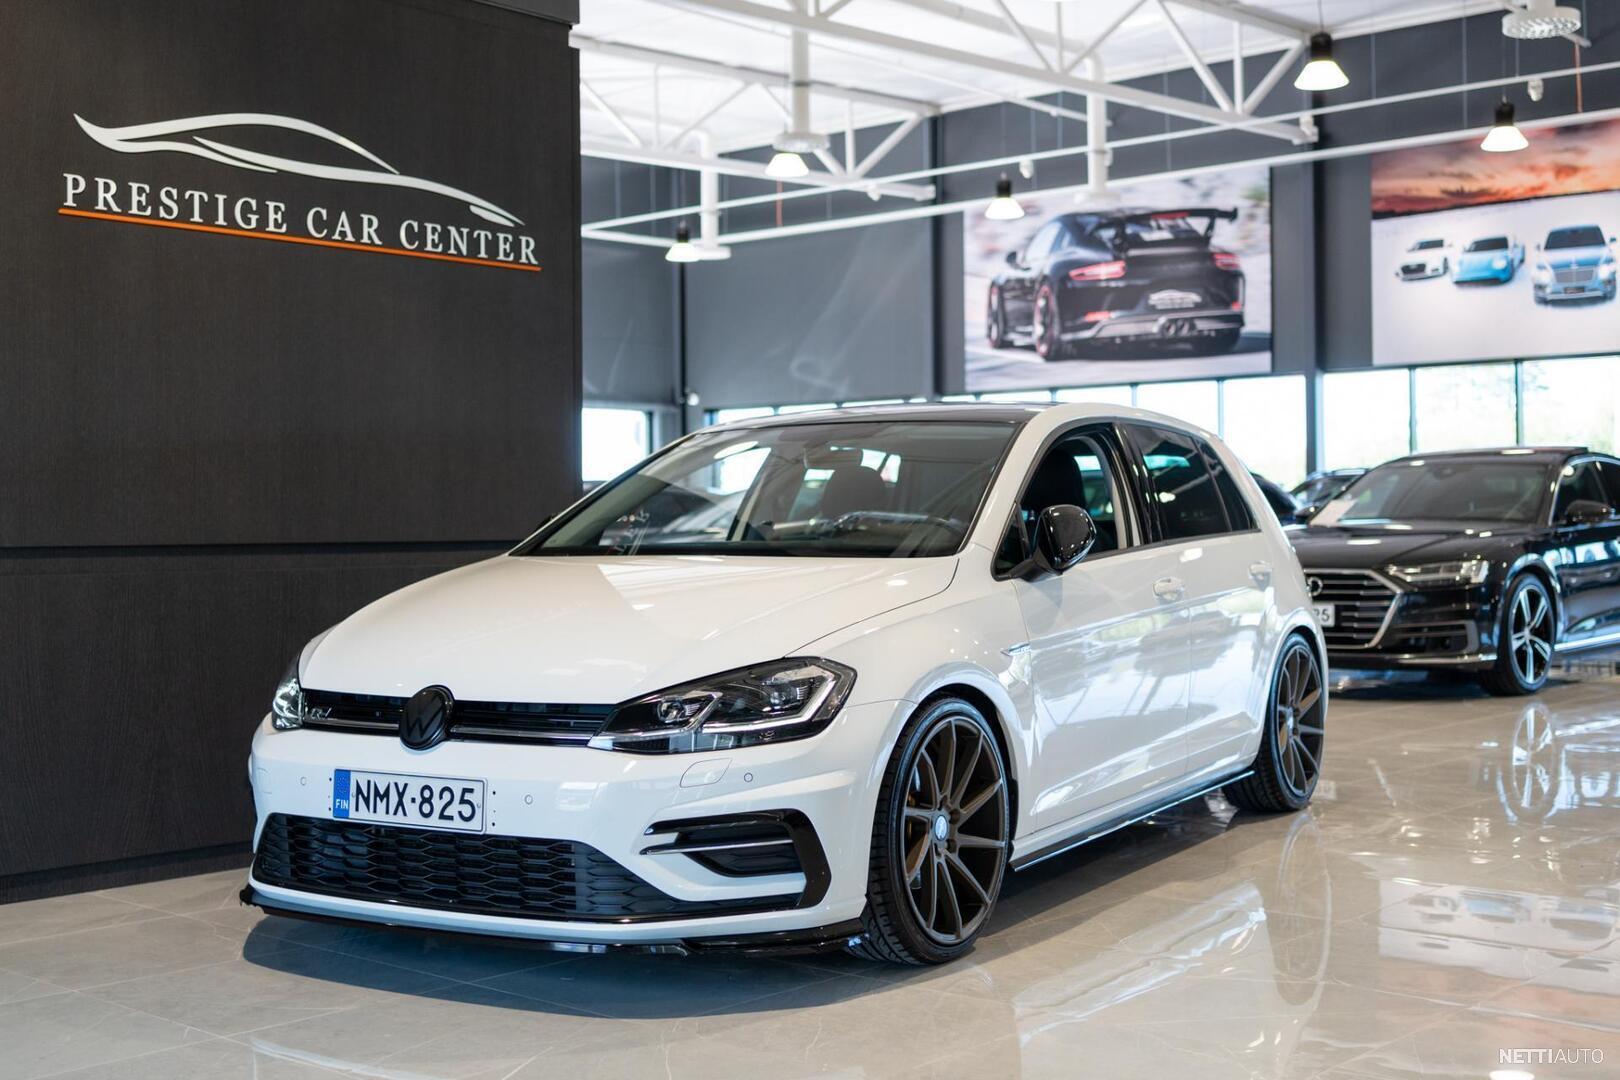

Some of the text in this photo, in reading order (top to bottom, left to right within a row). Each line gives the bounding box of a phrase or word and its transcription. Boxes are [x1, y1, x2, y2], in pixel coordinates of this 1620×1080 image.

[62, 172, 540, 265] PRESTIGE CAR CENTER
[335, 798, 350, 810] FIN
[354, 779, 477, 822] NMX-825
